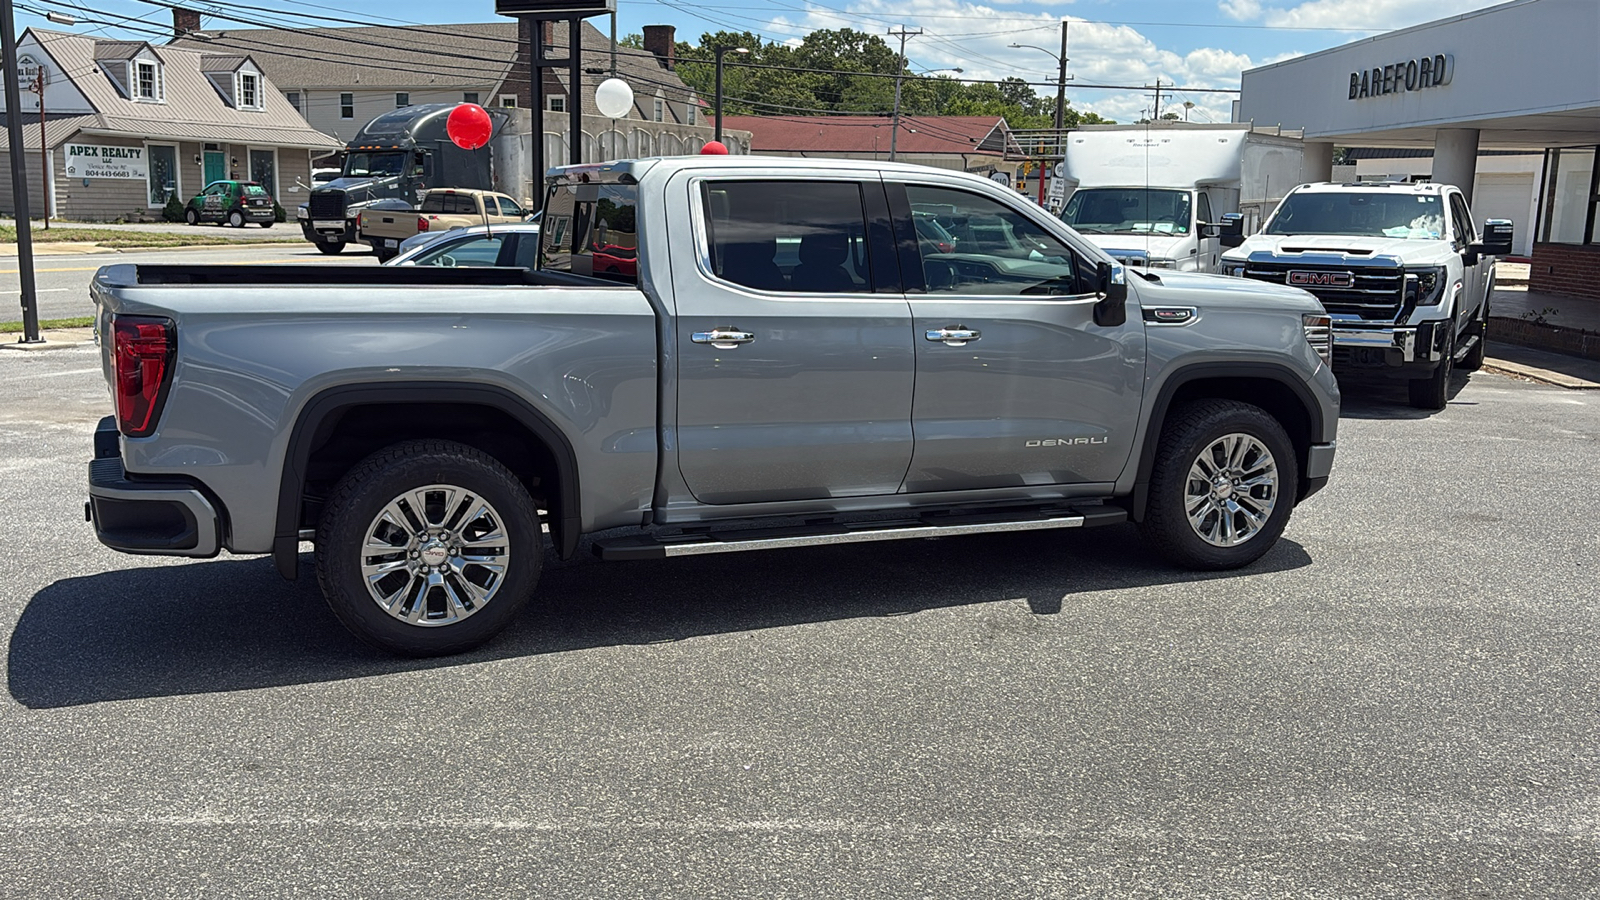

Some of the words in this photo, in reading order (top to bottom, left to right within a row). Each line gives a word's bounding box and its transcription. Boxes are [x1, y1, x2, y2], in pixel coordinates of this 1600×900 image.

[1348, 54, 1446, 100] BAREFORD
[70, 146, 98, 156] APEX
[102, 148, 141, 158] REALTY
[1291, 272, 1349, 285] GMC
[1025, 436, 1108, 447] DENALI
